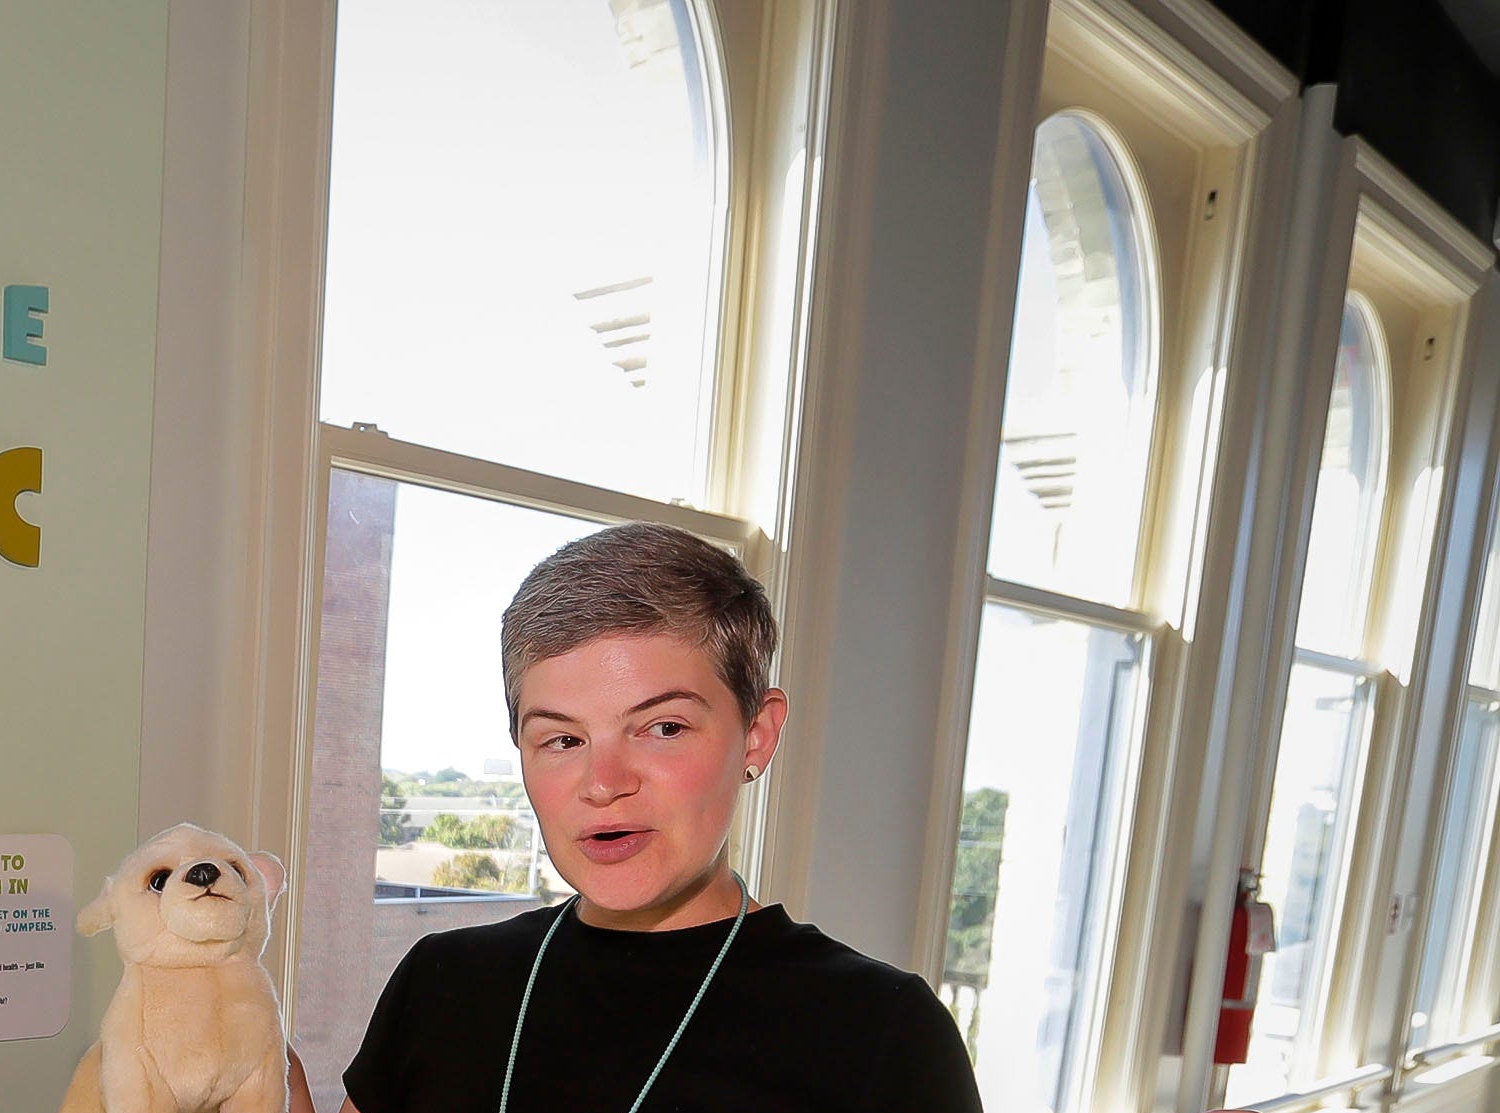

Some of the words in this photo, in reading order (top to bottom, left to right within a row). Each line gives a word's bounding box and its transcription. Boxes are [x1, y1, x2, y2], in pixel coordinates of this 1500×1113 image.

[1, 854, 25, 871] TO
[8, 878, 29, 894] IN
[13, 909, 28, 919] ON
[32, 908, 50, 918] THE
[5, 922, 57, 933] JUMPERS.
